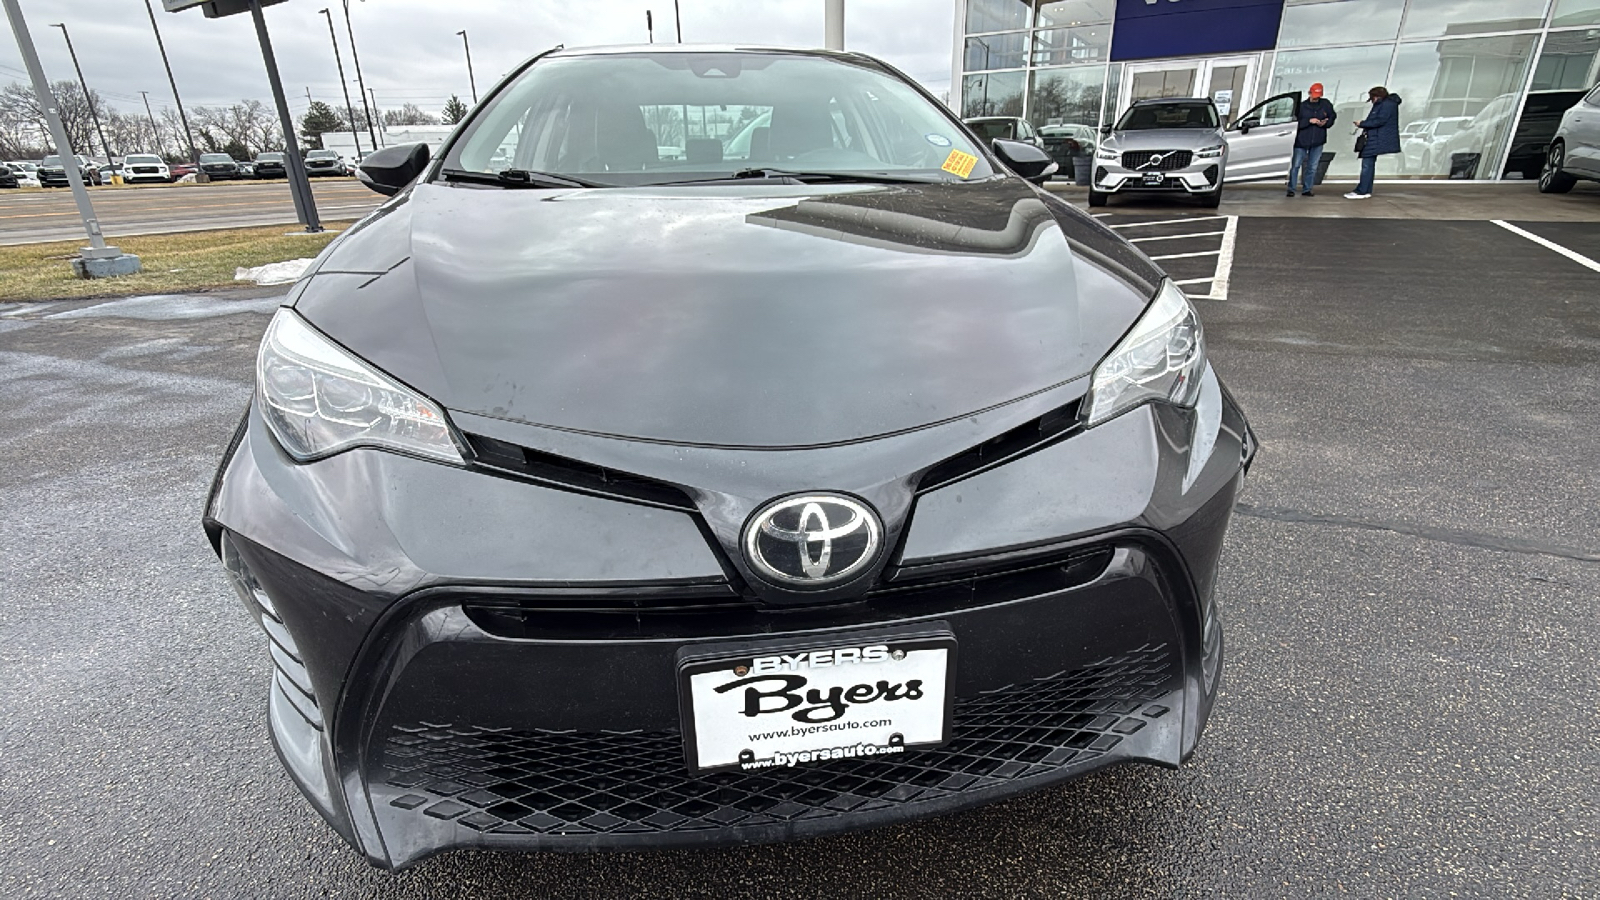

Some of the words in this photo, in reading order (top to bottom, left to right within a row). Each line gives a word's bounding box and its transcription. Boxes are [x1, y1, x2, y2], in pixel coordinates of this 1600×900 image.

[752, 645, 889, 674] BYERS
[713, 675, 924, 723] Byers
[748, 717, 892, 742] www.byersauto.com
[741, 741, 904, 770] www.byersauto.com
